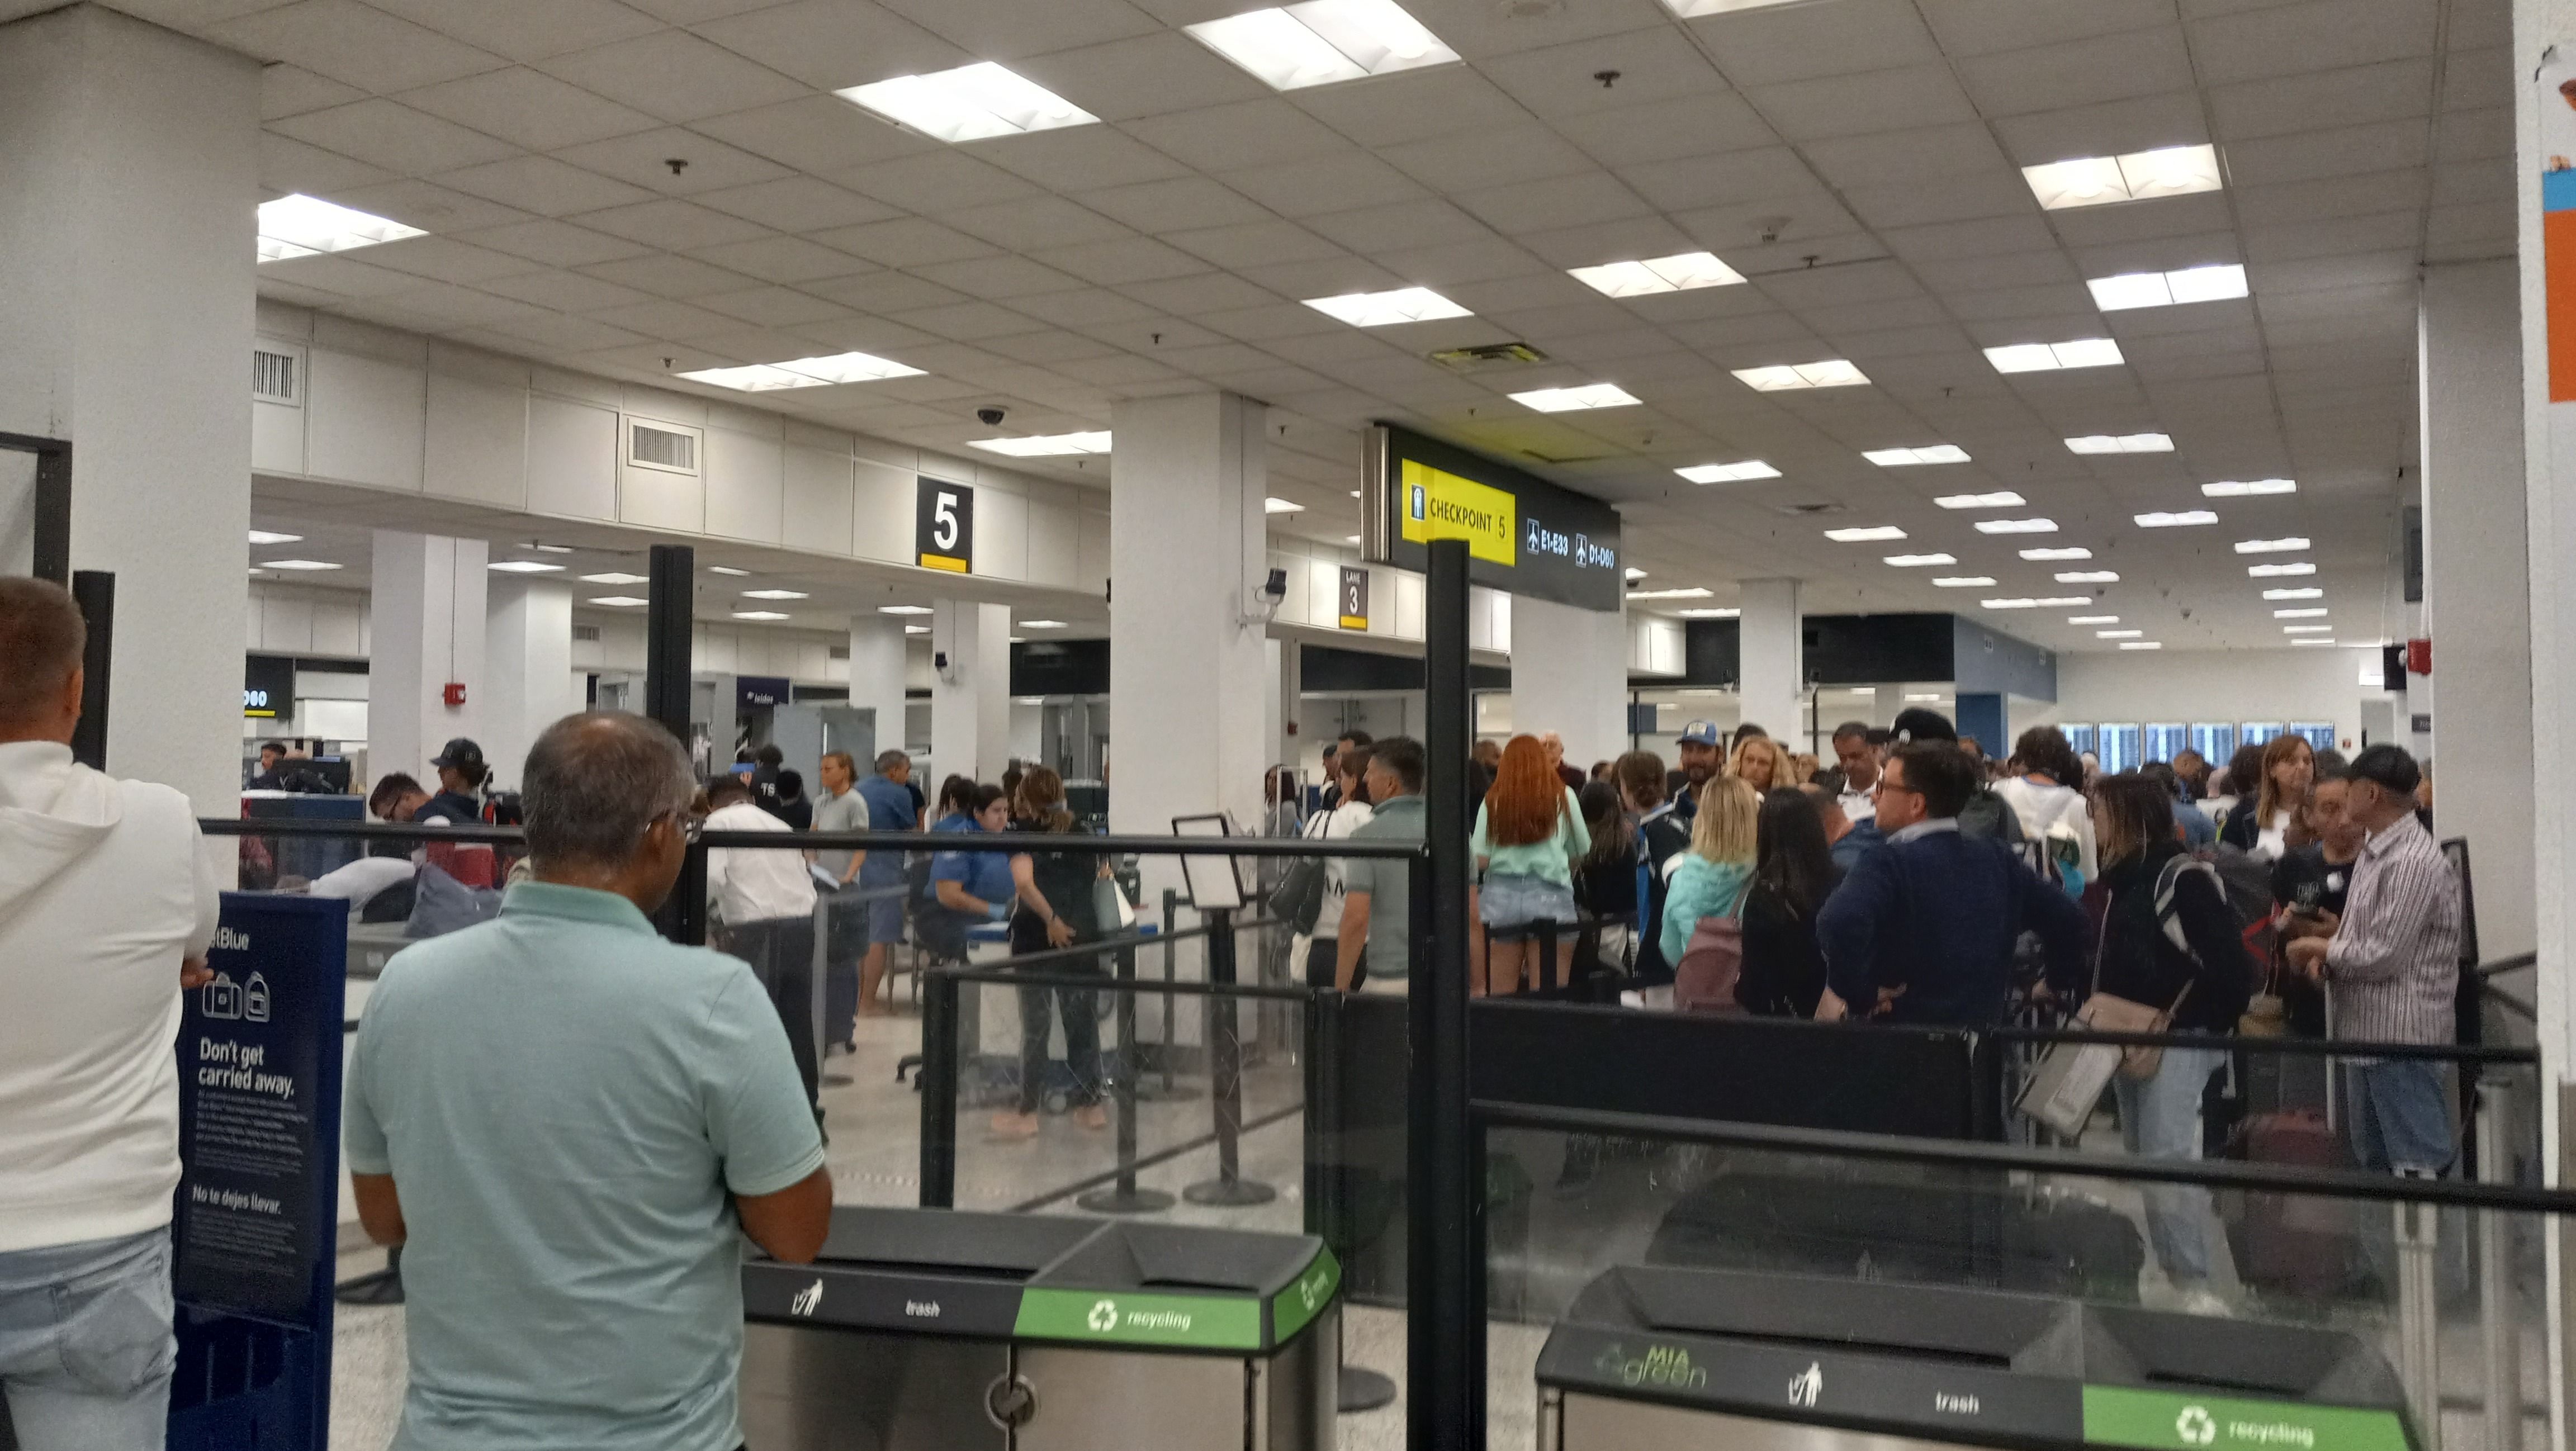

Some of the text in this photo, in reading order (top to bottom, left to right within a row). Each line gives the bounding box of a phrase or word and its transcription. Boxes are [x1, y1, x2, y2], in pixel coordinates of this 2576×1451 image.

[934, 491, 958, 550] 5
[1430, 497, 1492, 533] CHECKPOINT
[1499, 514, 1505, 538] 5
[1541, 529, 1568, 556] E1-E33
[1346, 570, 1360, 585] LANE
[1349, 585, 1358, 615] 3
[200, 1036, 264, 1070] Don't get
[198, 1065, 294, 1101] carried away.
[192, 1183, 208, 1202] No
[905, 1299, 940, 1317] trash
[1127, 1311, 1191, 1332] recycling
[1646, 1344, 1690, 1365] MIA
